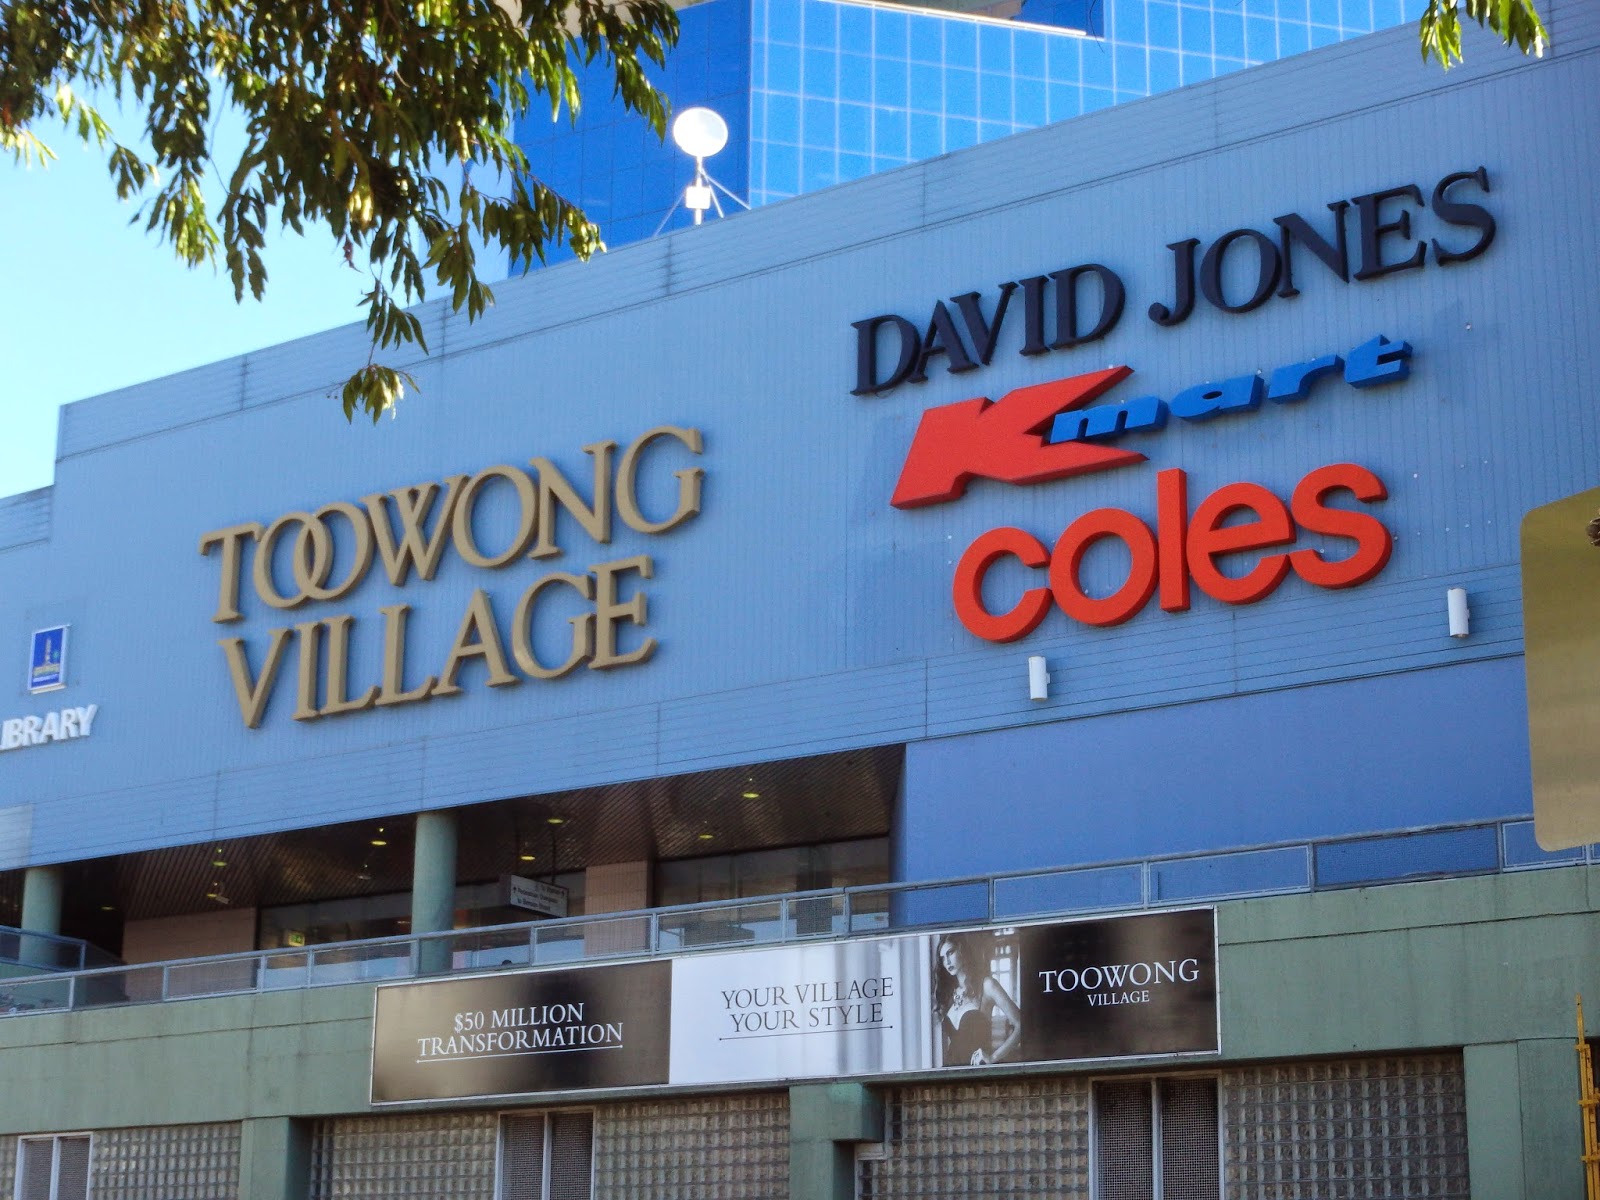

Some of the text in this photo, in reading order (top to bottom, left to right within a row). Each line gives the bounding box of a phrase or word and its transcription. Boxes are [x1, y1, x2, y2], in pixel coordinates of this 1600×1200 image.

[849, 165, 1496, 397] DAVID JONES
[199, 425, 705, 624] TOOWONG
[952, 463, 1393, 642] coles
[217, 554, 658, 730] VILLAGE
[721, 977, 894, 1009] YOUR VILLAGE
[1038, 958, 1200, 993] TOOWONG
[1087, 990, 1150, 1007] VILLAGE
[454, 1002, 584, 1034] $50 MILLION
[730, 1002, 884, 1033] YOUR STYLE
[417, 1022, 624, 1057] TRANSFORMATION
